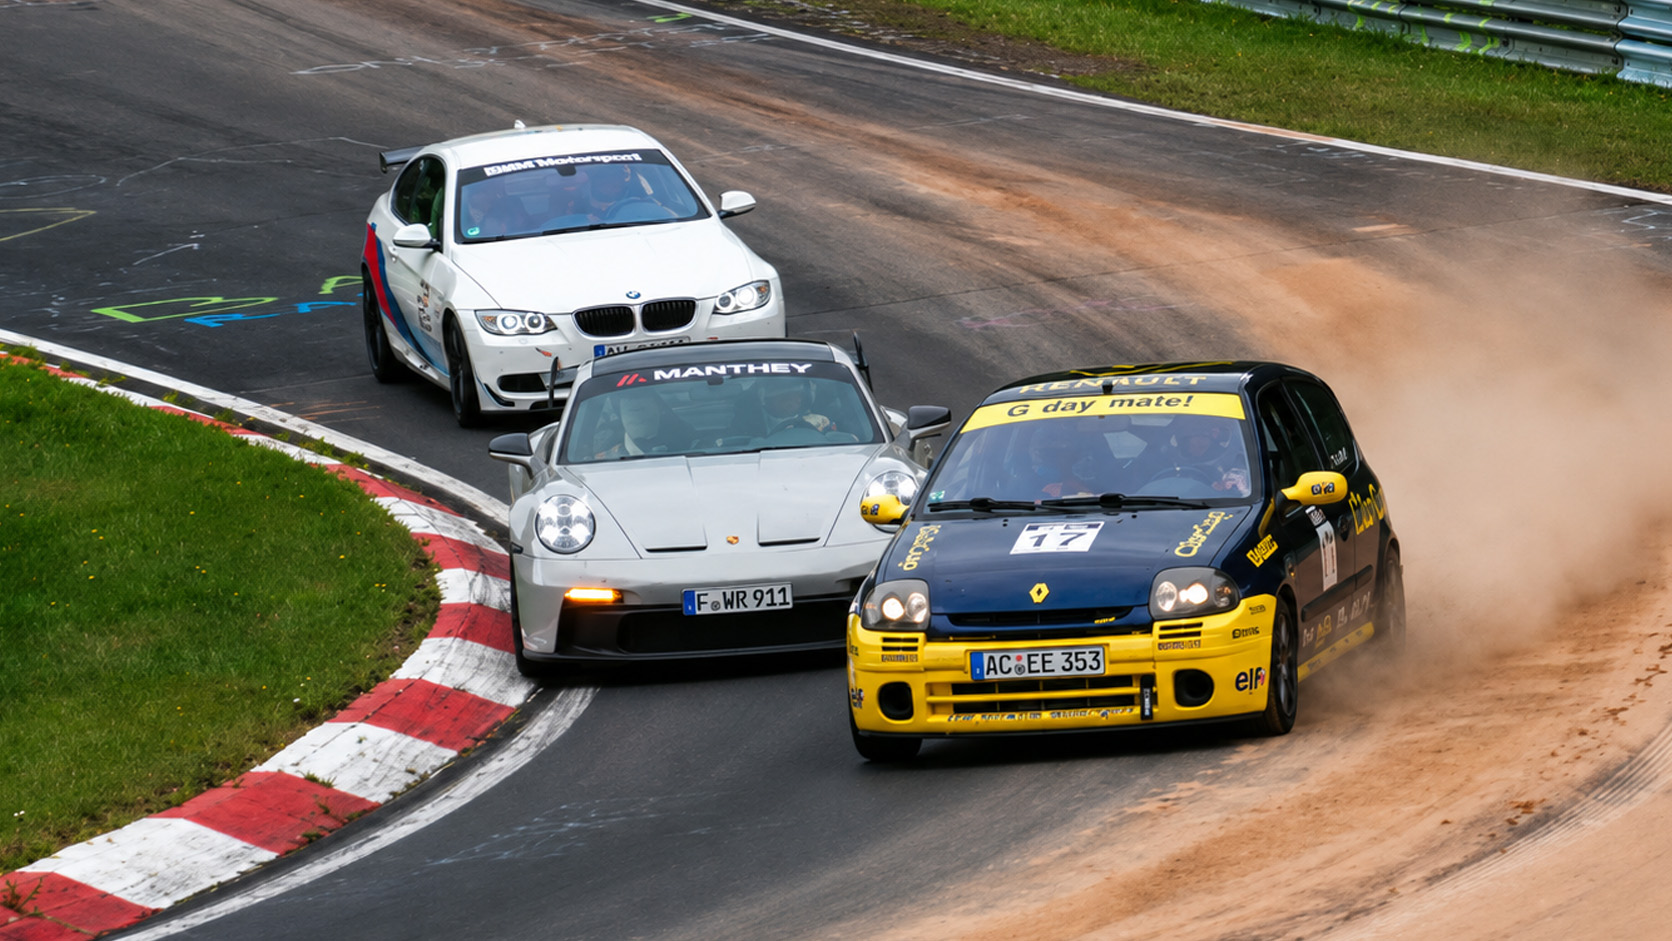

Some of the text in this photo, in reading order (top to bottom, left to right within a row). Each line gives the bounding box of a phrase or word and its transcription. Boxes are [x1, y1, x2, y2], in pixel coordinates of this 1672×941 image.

[653, 363, 813, 381] MANTHEY
[1019, 376, 1208, 394] RENAULT
[1007, 394, 1194, 417] G day mate!
[1029, 532, 1088, 548] 17
[696, 586, 790, 612] F WR 911
[986, 650, 1101, 676] AC EE 353
[1234, 666, 1265, 692] elf
